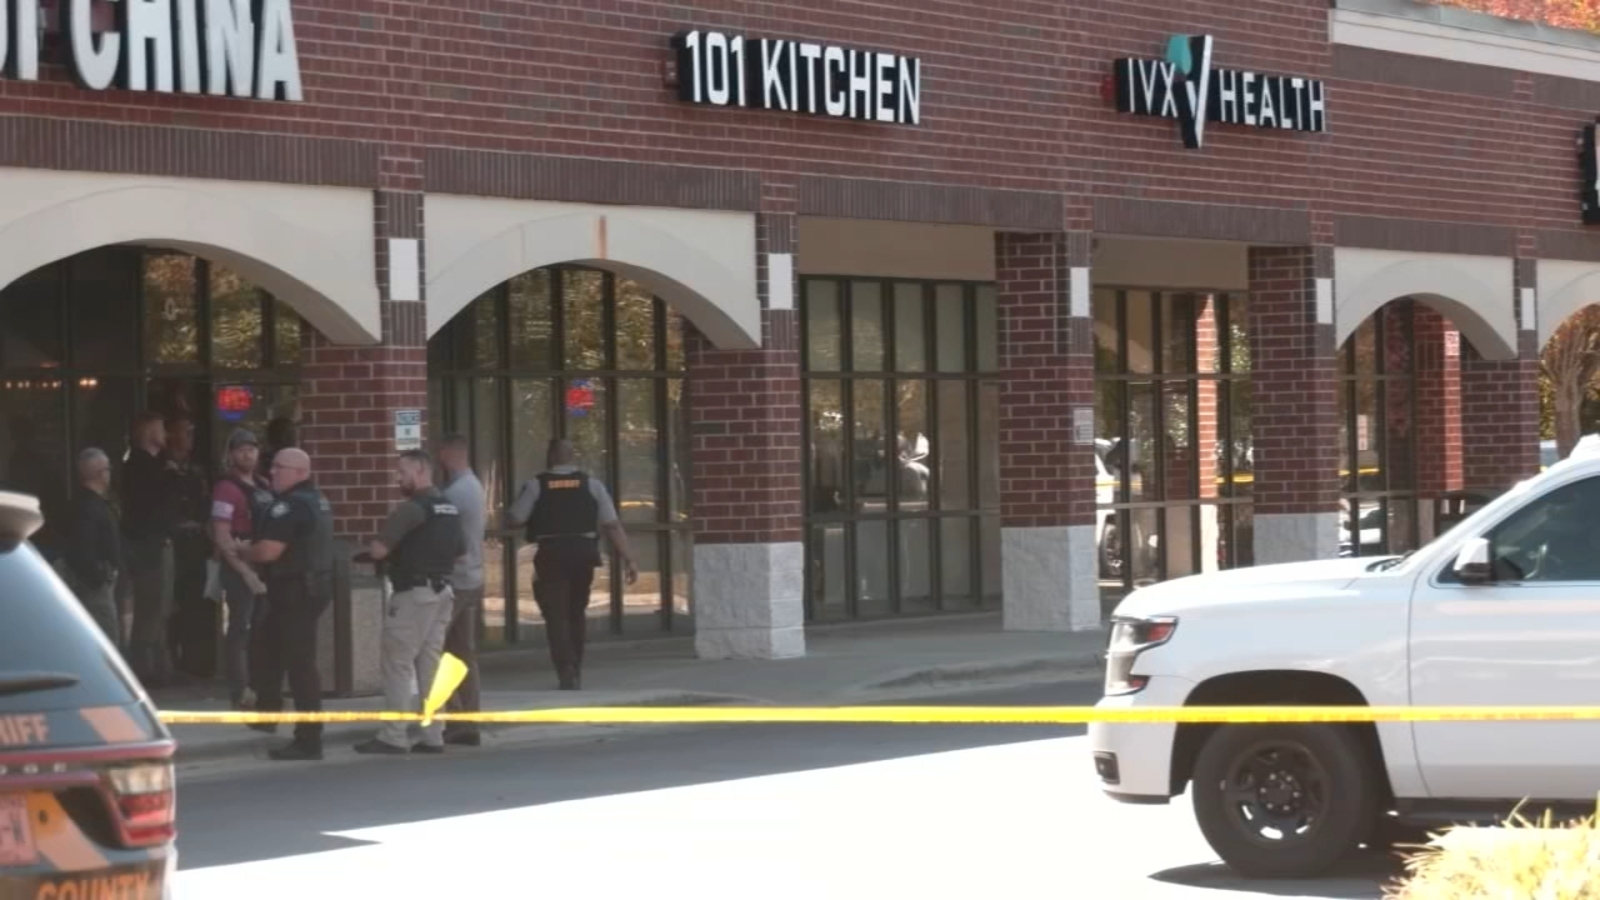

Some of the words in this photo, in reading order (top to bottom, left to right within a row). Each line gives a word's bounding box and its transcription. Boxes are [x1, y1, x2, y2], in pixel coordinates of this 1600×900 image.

[69, 0, 303, 100] CHINA
[686, 30, 746, 107] 101
[761, 38, 921, 125] KITCHEN
[1127, 57, 1179, 118] IVX
[1218, 69, 1326, 132] HEALTH
